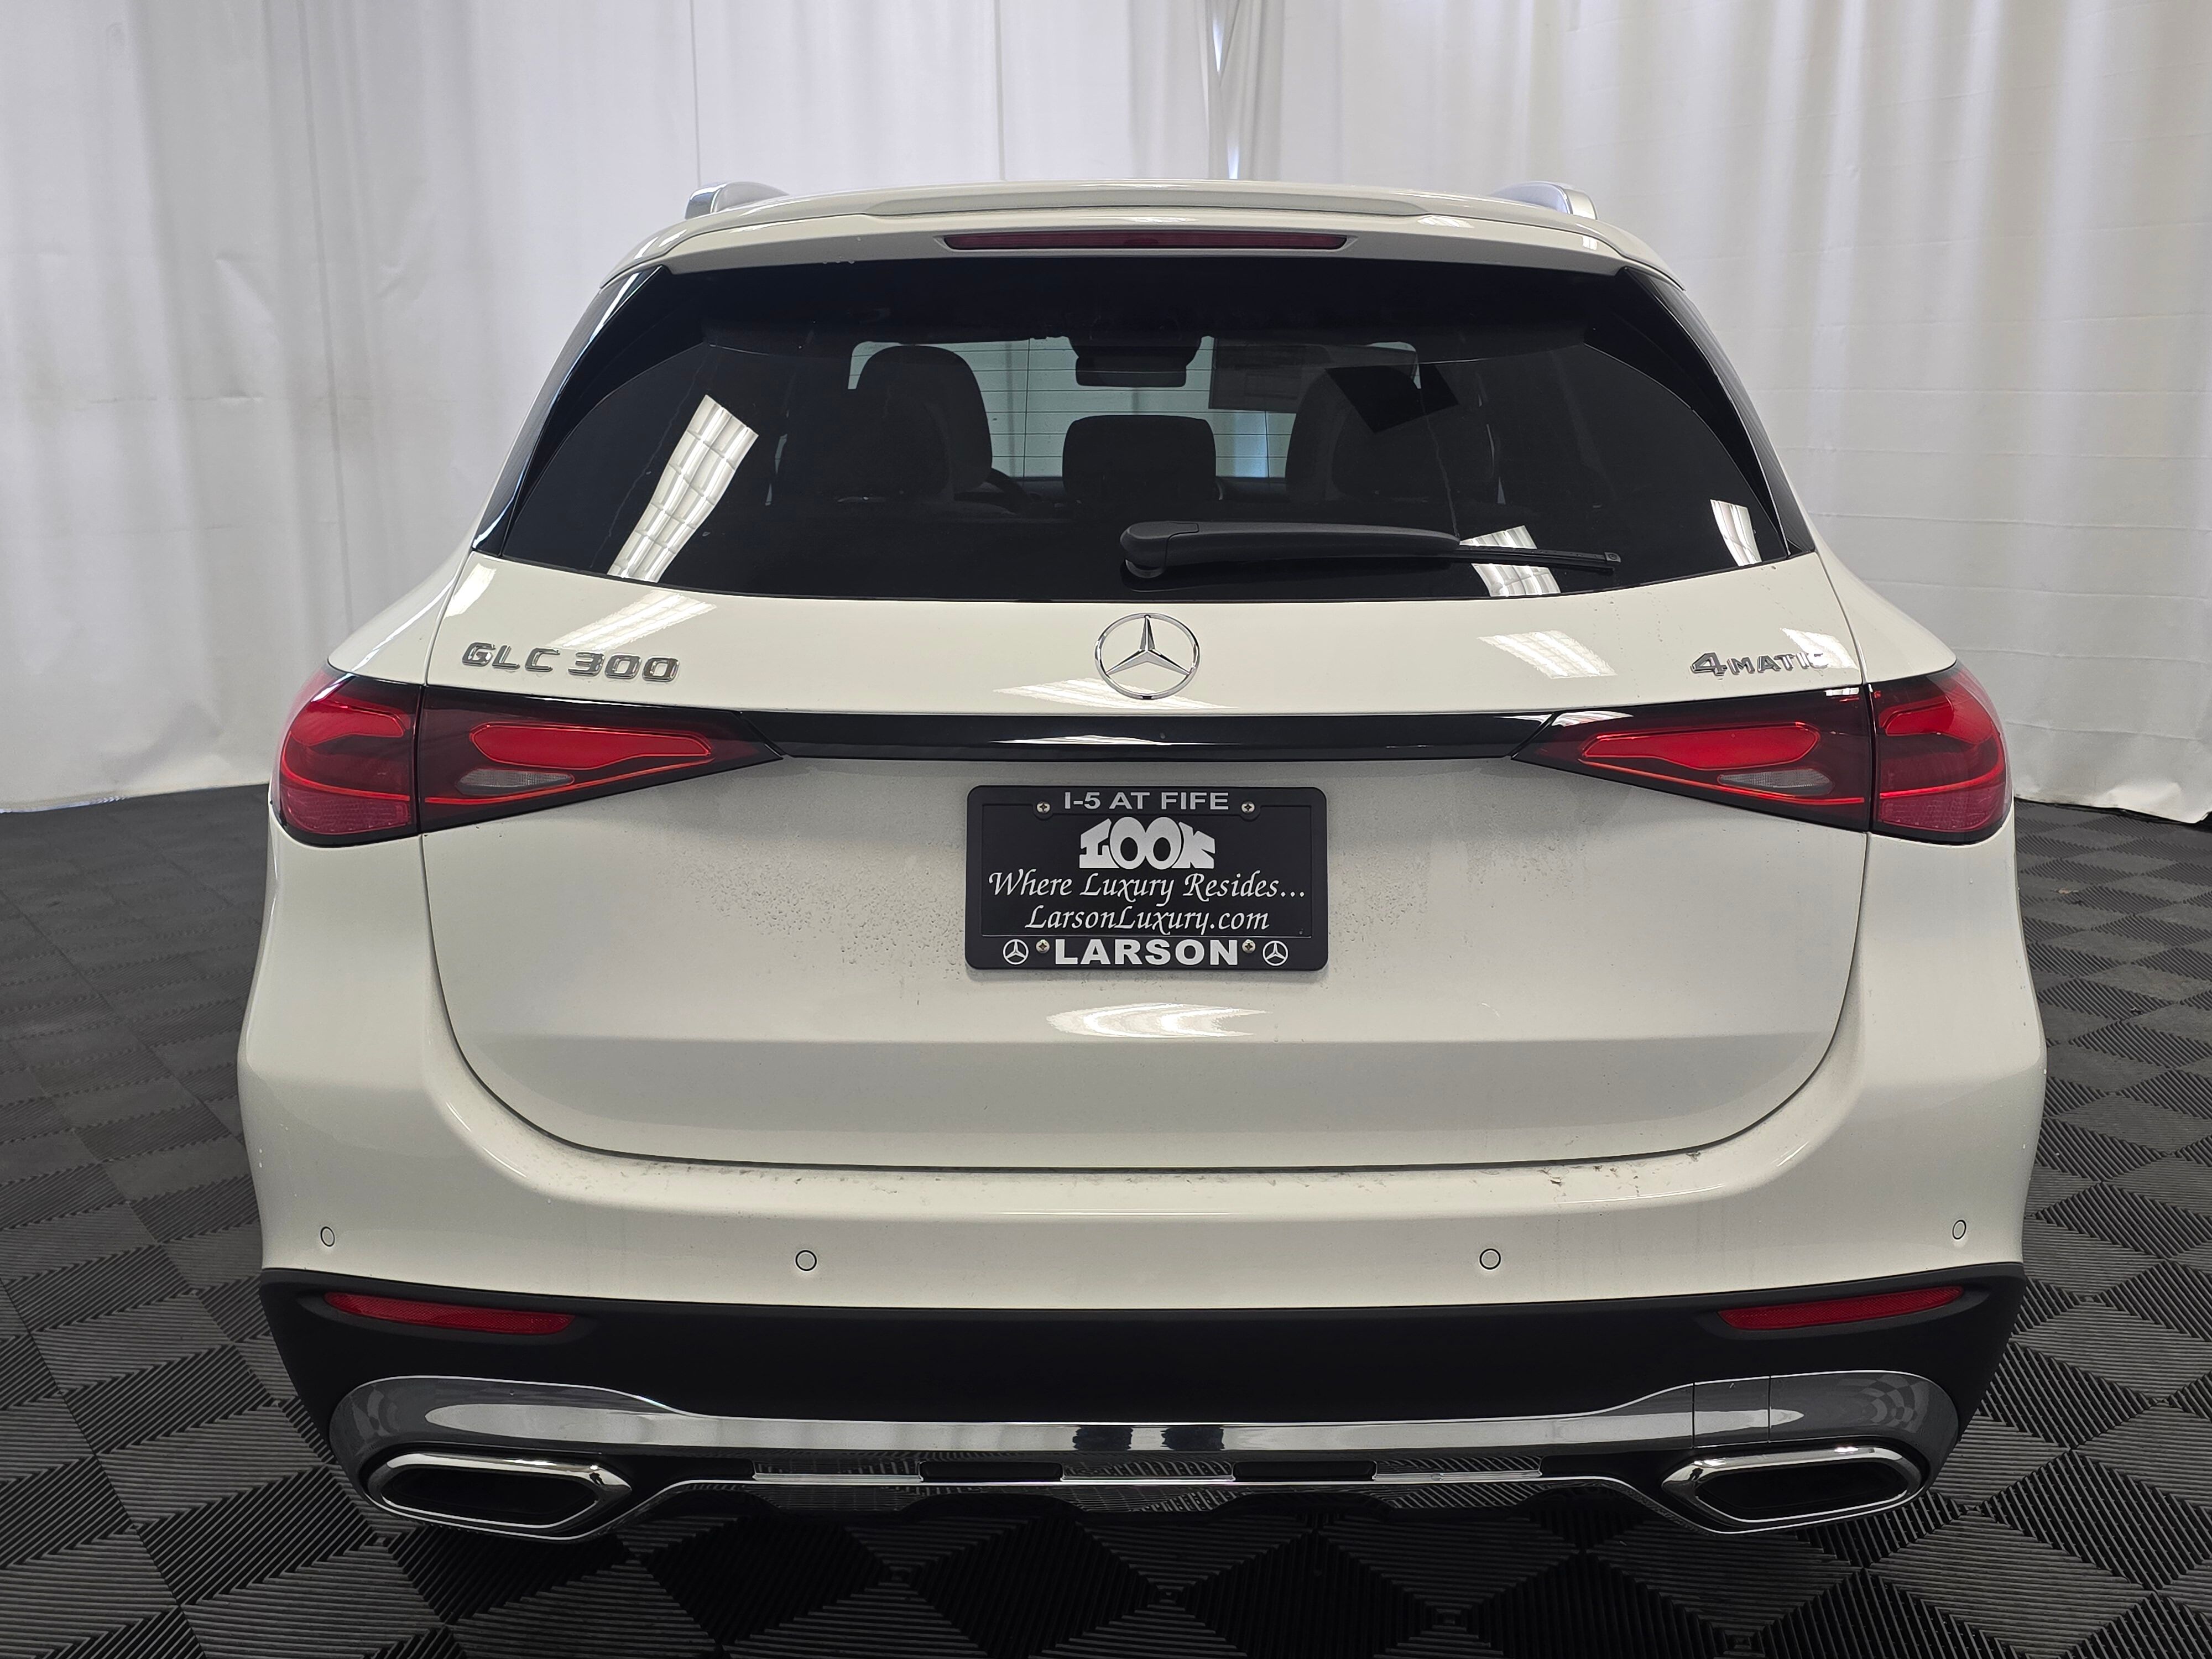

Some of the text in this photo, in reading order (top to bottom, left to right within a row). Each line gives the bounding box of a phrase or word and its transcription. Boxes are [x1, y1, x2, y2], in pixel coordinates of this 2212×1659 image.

[462, 642, 680, 682] GLC 300
[1065, 792, 1229, 810] I-5 AT FIFE
[989, 869, 1306, 906] Where Luxury Resides...
[1025, 905, 1270, 935] LarsonLuxury.com
[1055, 940, 1238, 965] LARSON
